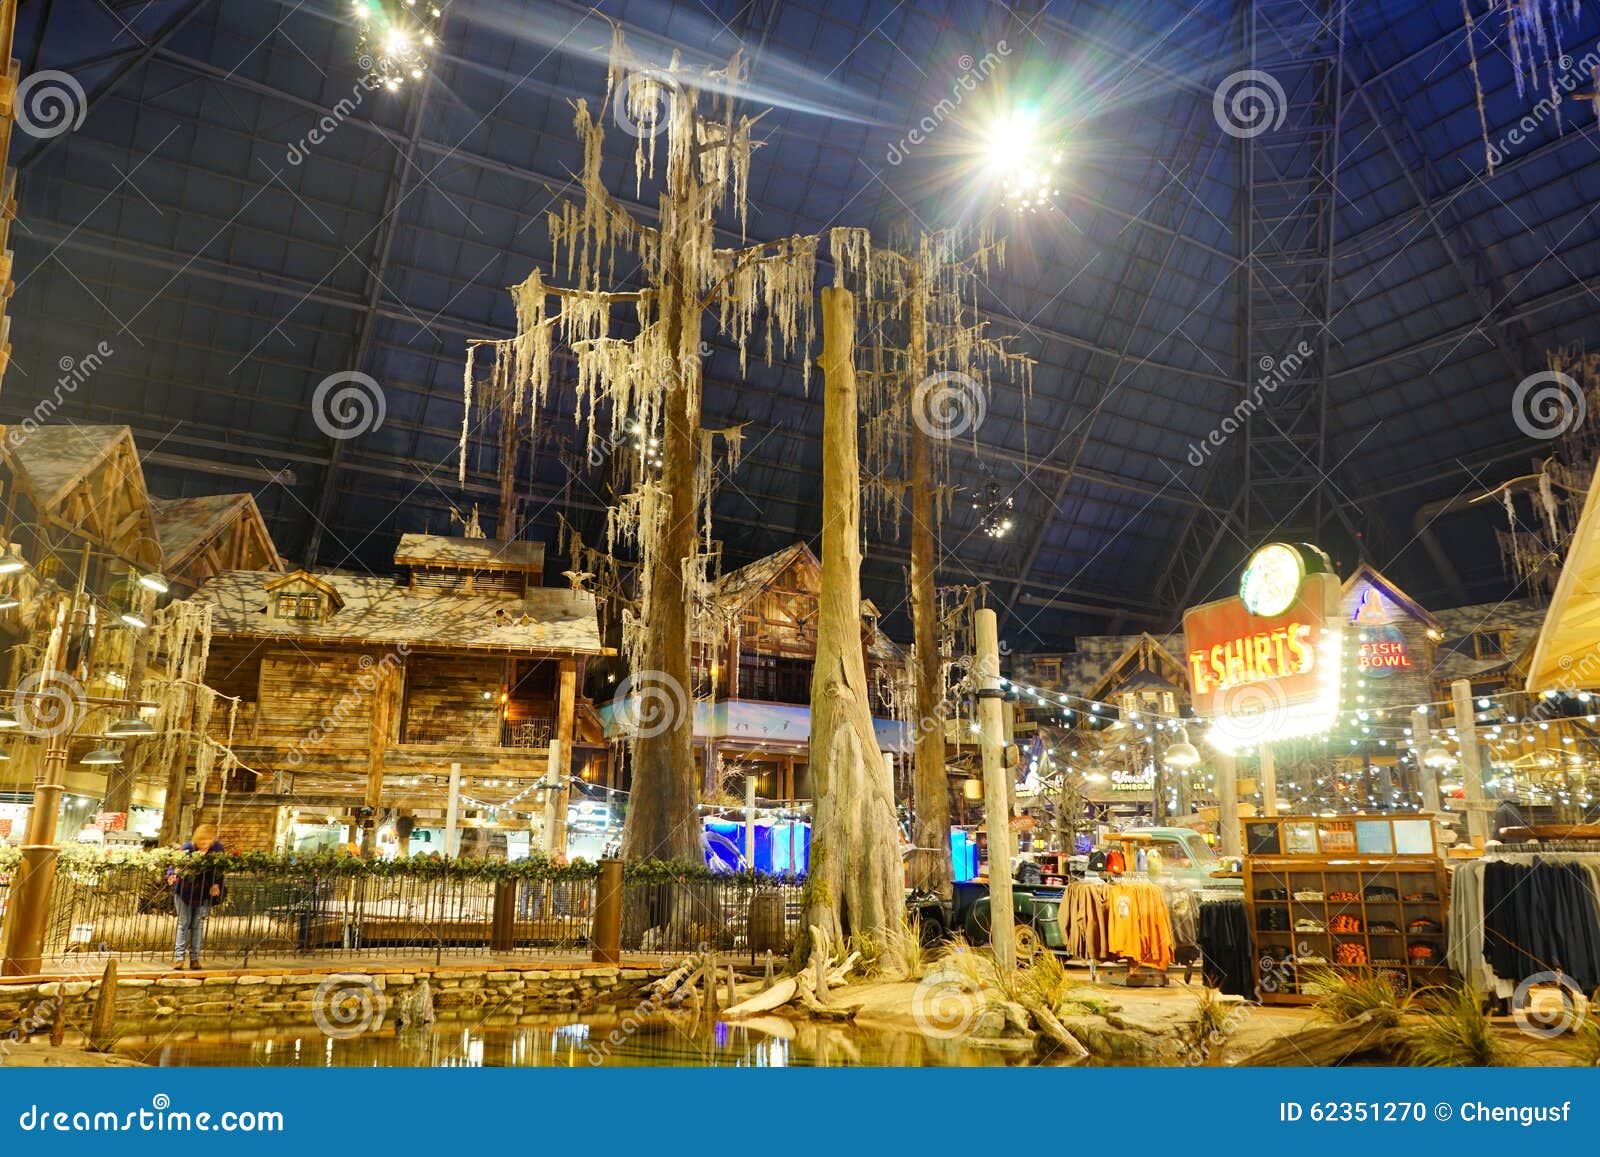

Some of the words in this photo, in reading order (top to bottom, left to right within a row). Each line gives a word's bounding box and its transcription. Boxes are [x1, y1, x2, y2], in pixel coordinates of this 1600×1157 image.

[1361, 643, 1402, 655] FISH
[1190, 622, 1313, 694] T-SHIRTS
[1359, 655, 1412, 668] BOWL
